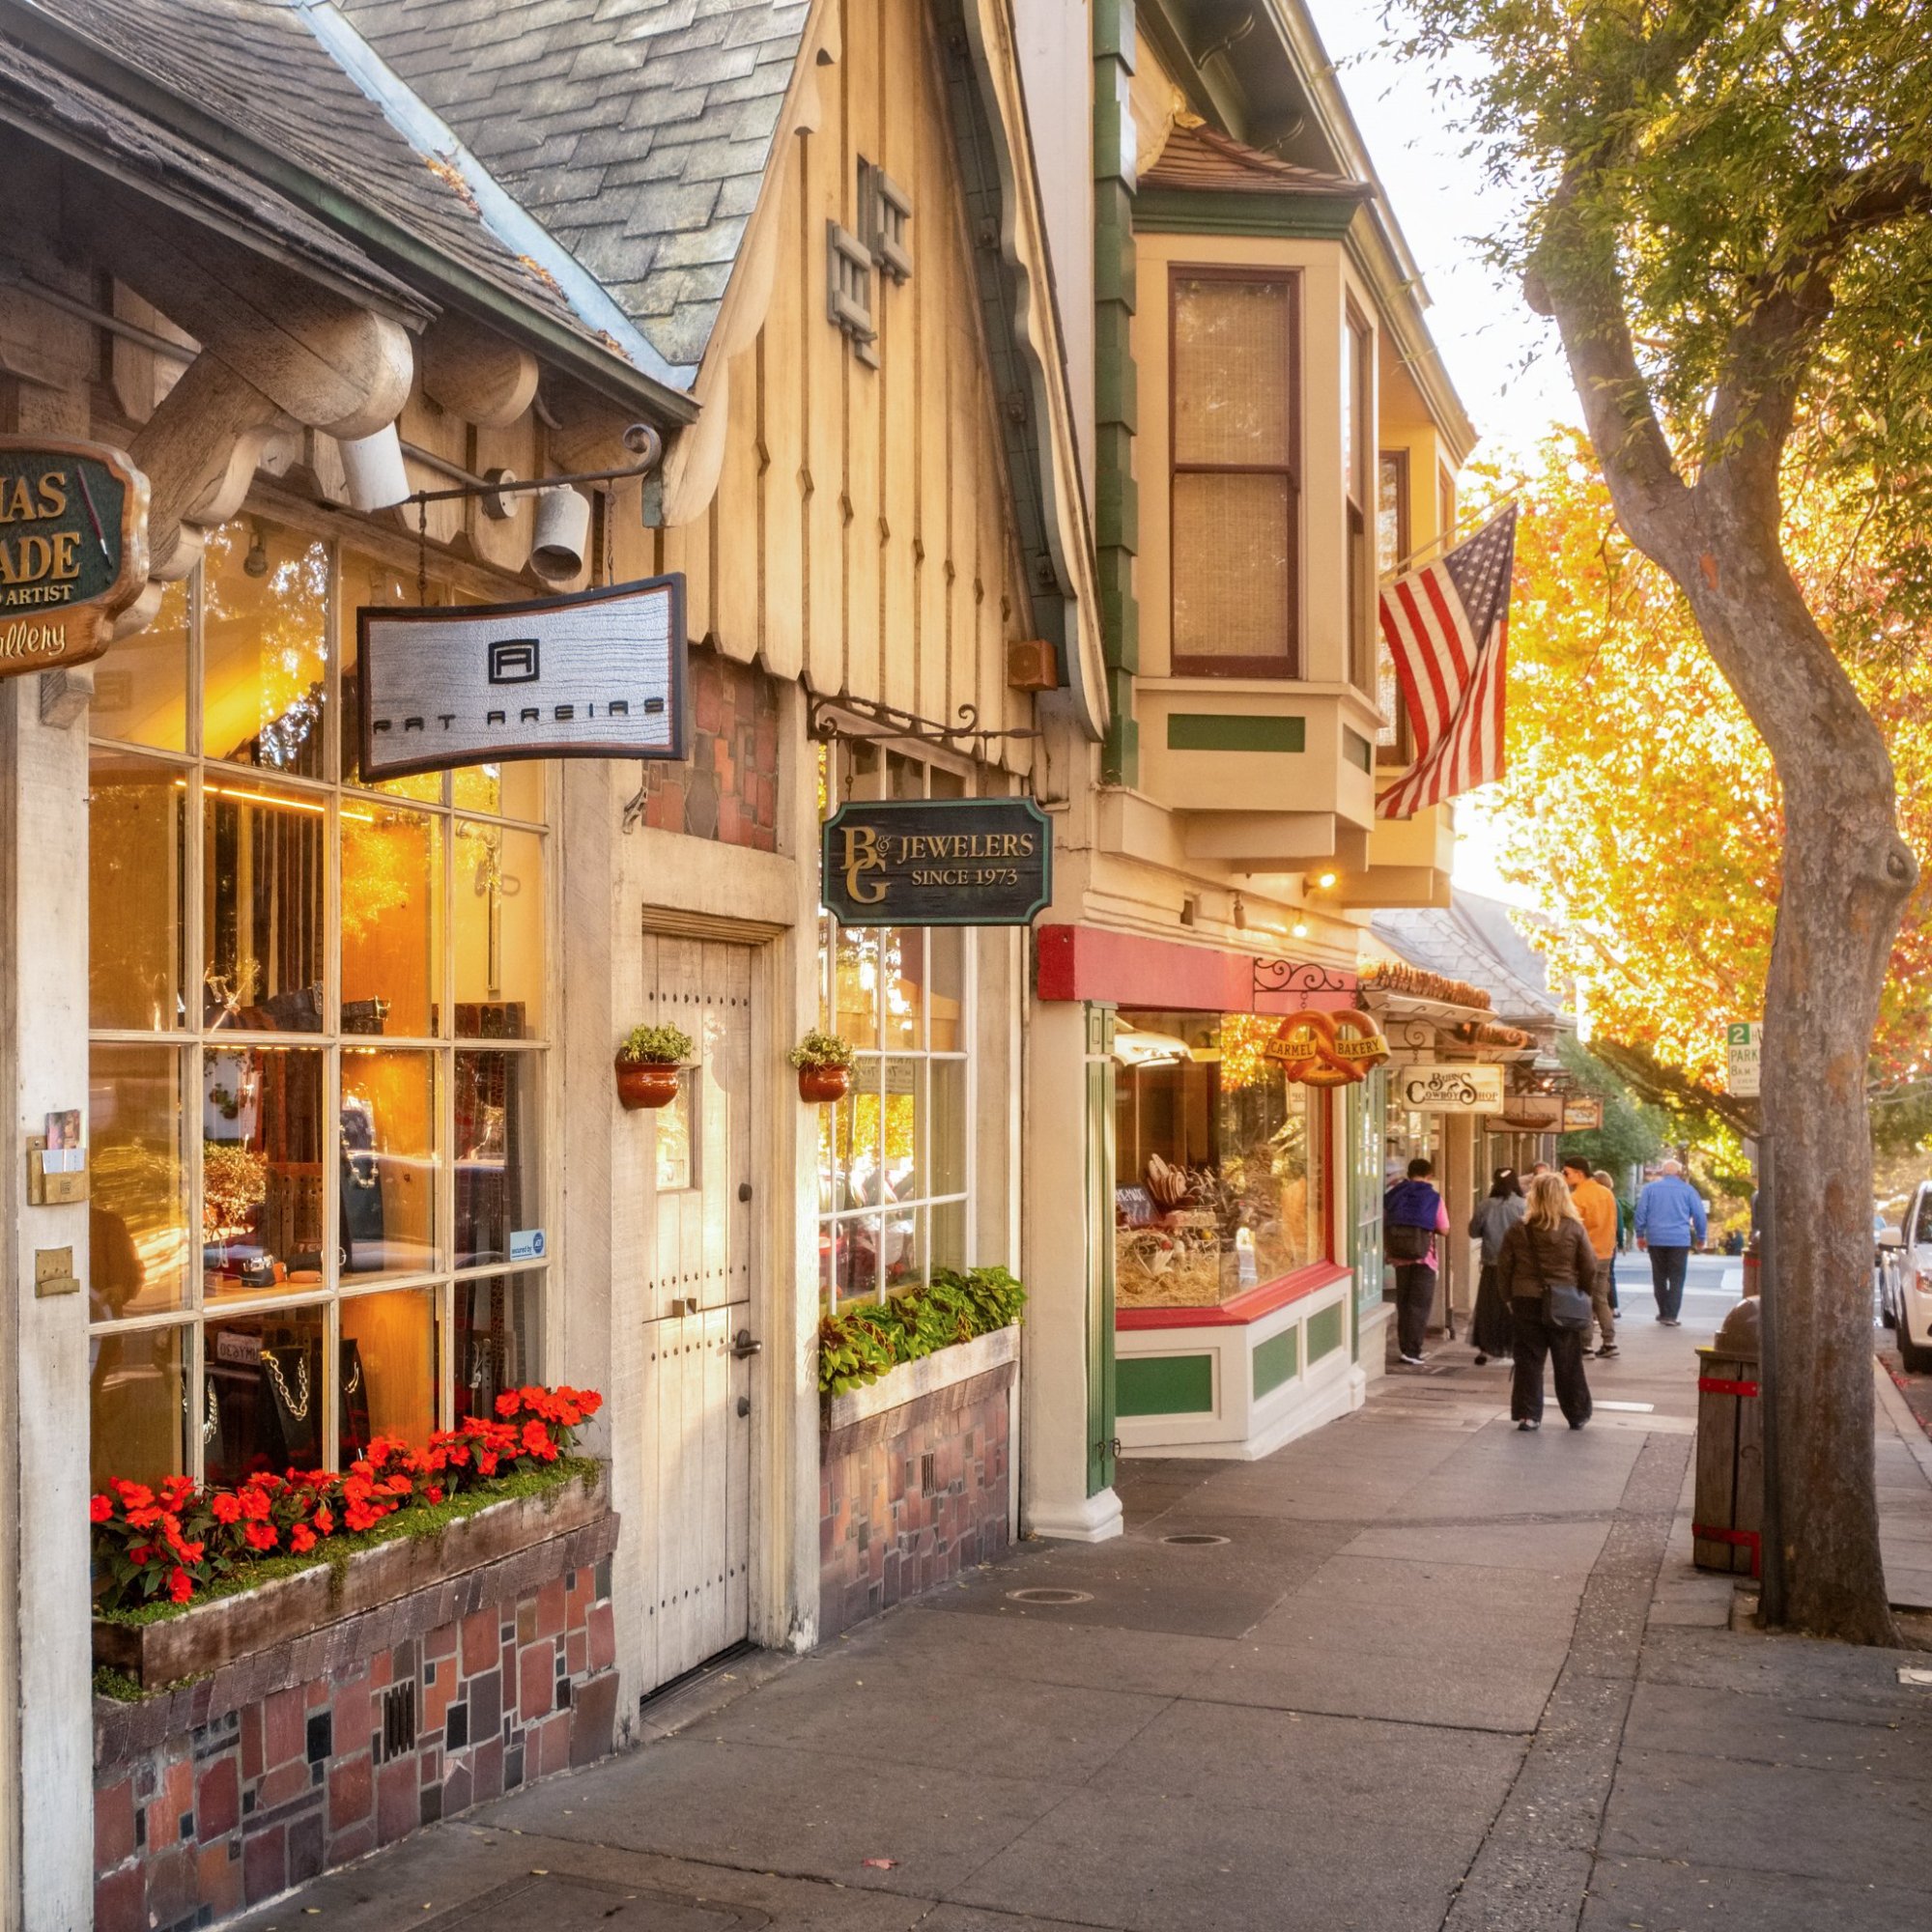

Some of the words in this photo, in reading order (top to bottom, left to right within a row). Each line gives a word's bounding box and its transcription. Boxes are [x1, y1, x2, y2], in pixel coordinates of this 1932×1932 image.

[0, 471, 67, 523] AS
[6, 583, 73, 606] ARTIST
[374, 714, 456, 734] PAT
[487, 696, 665, 724] AREIAS
[896, 833, 1035, 865] JEWELERS
[912, 870, 967, 886] SINCE
[976, 869, 1018, 886] 1973
[1270, 1042, 1313, 1057] CARMEL
[1337, 1039, 1379, 1055] BAKERY
[1732, 1026, 1746, 1043] 2
[1406, 1080, 1460, 1104] COWBOY
[1460, 1072, 1498, 1105] SHOP
